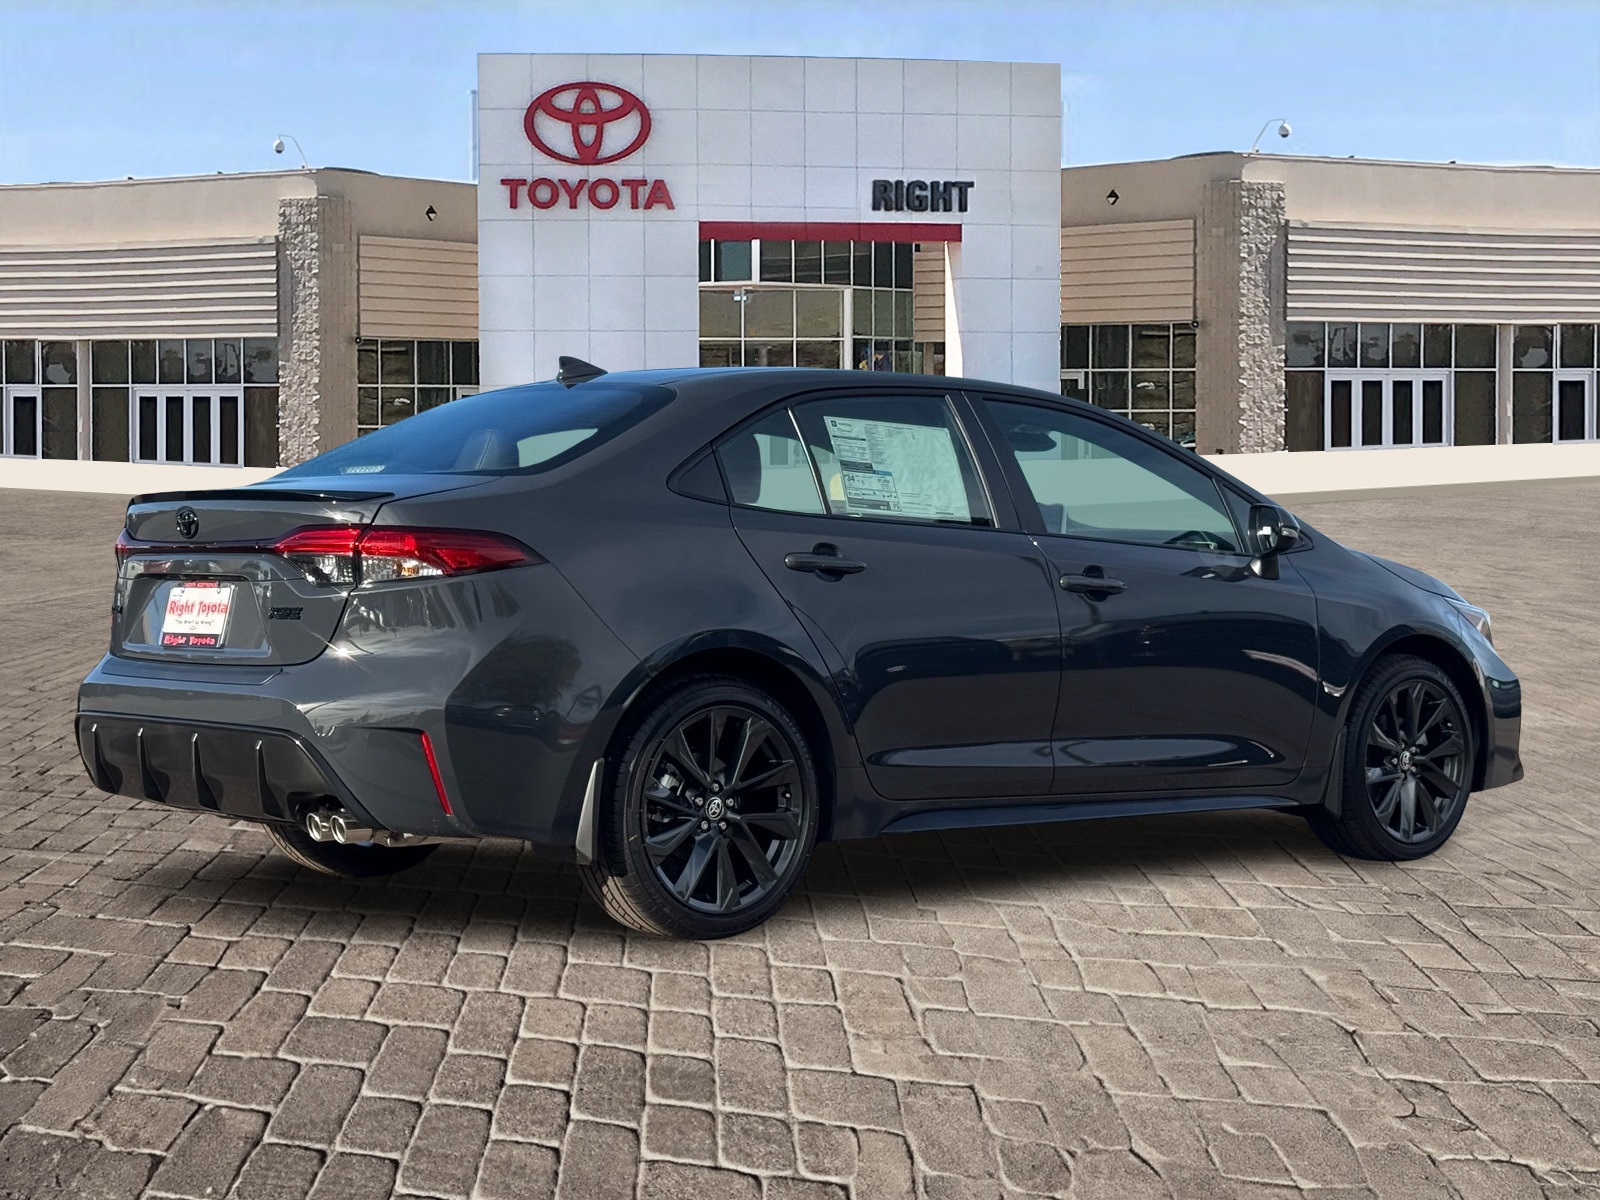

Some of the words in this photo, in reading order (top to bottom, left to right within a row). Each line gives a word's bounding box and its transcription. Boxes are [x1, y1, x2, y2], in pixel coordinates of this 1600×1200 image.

[500, 178, 675, 211] TOYOTA
[872, 179, 975, 212] RIGHT
[169, 600, 195, 616] Right
[197, 600, 228, 617] Toyota
[164, 634, 187, 645] Right
[189, 635, 216, 646] Toyota
